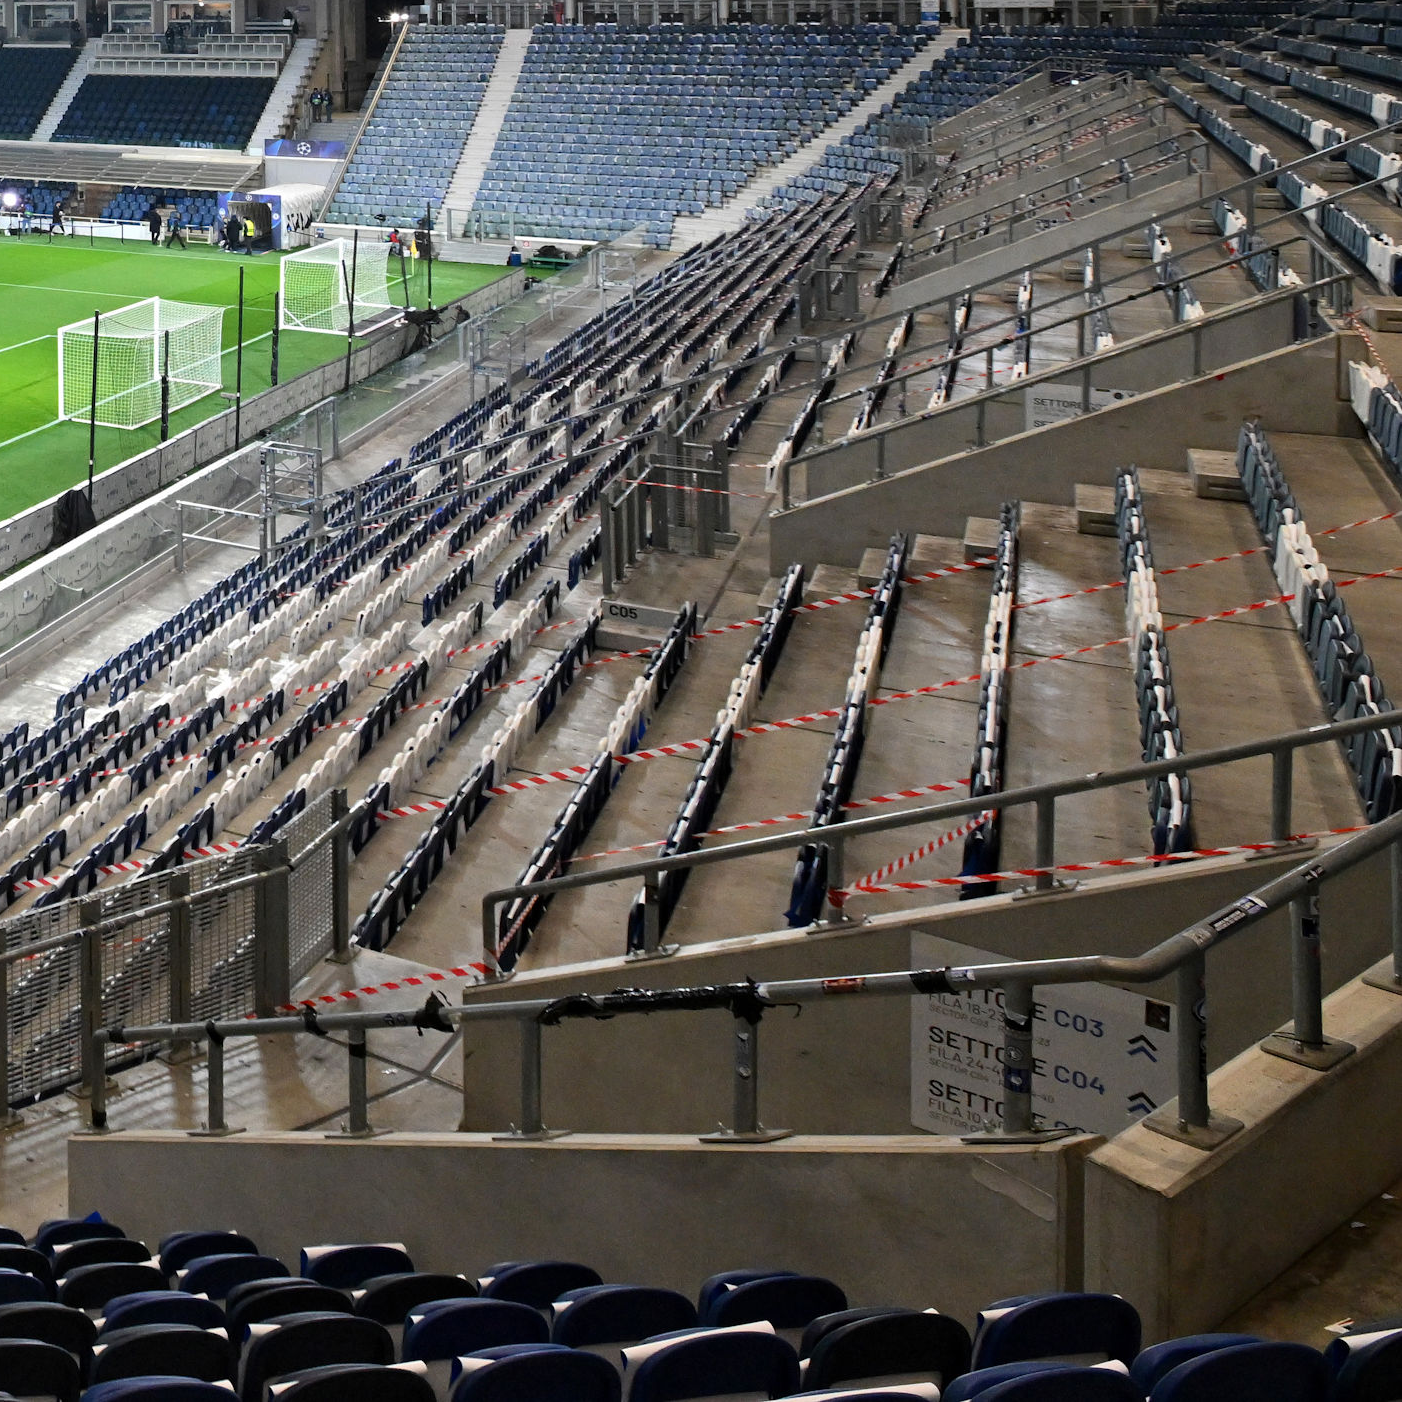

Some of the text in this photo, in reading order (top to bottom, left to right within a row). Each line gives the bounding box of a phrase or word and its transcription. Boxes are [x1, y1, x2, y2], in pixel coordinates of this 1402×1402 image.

[609, 604, 638, 619] C05
[1054, 1009, 1104, 1038] C03
[929, 1044, 963, 1064] FILA
[1054, 1065, 1106, 1095] C04
[929, 1097, 963, 1118] FILA
